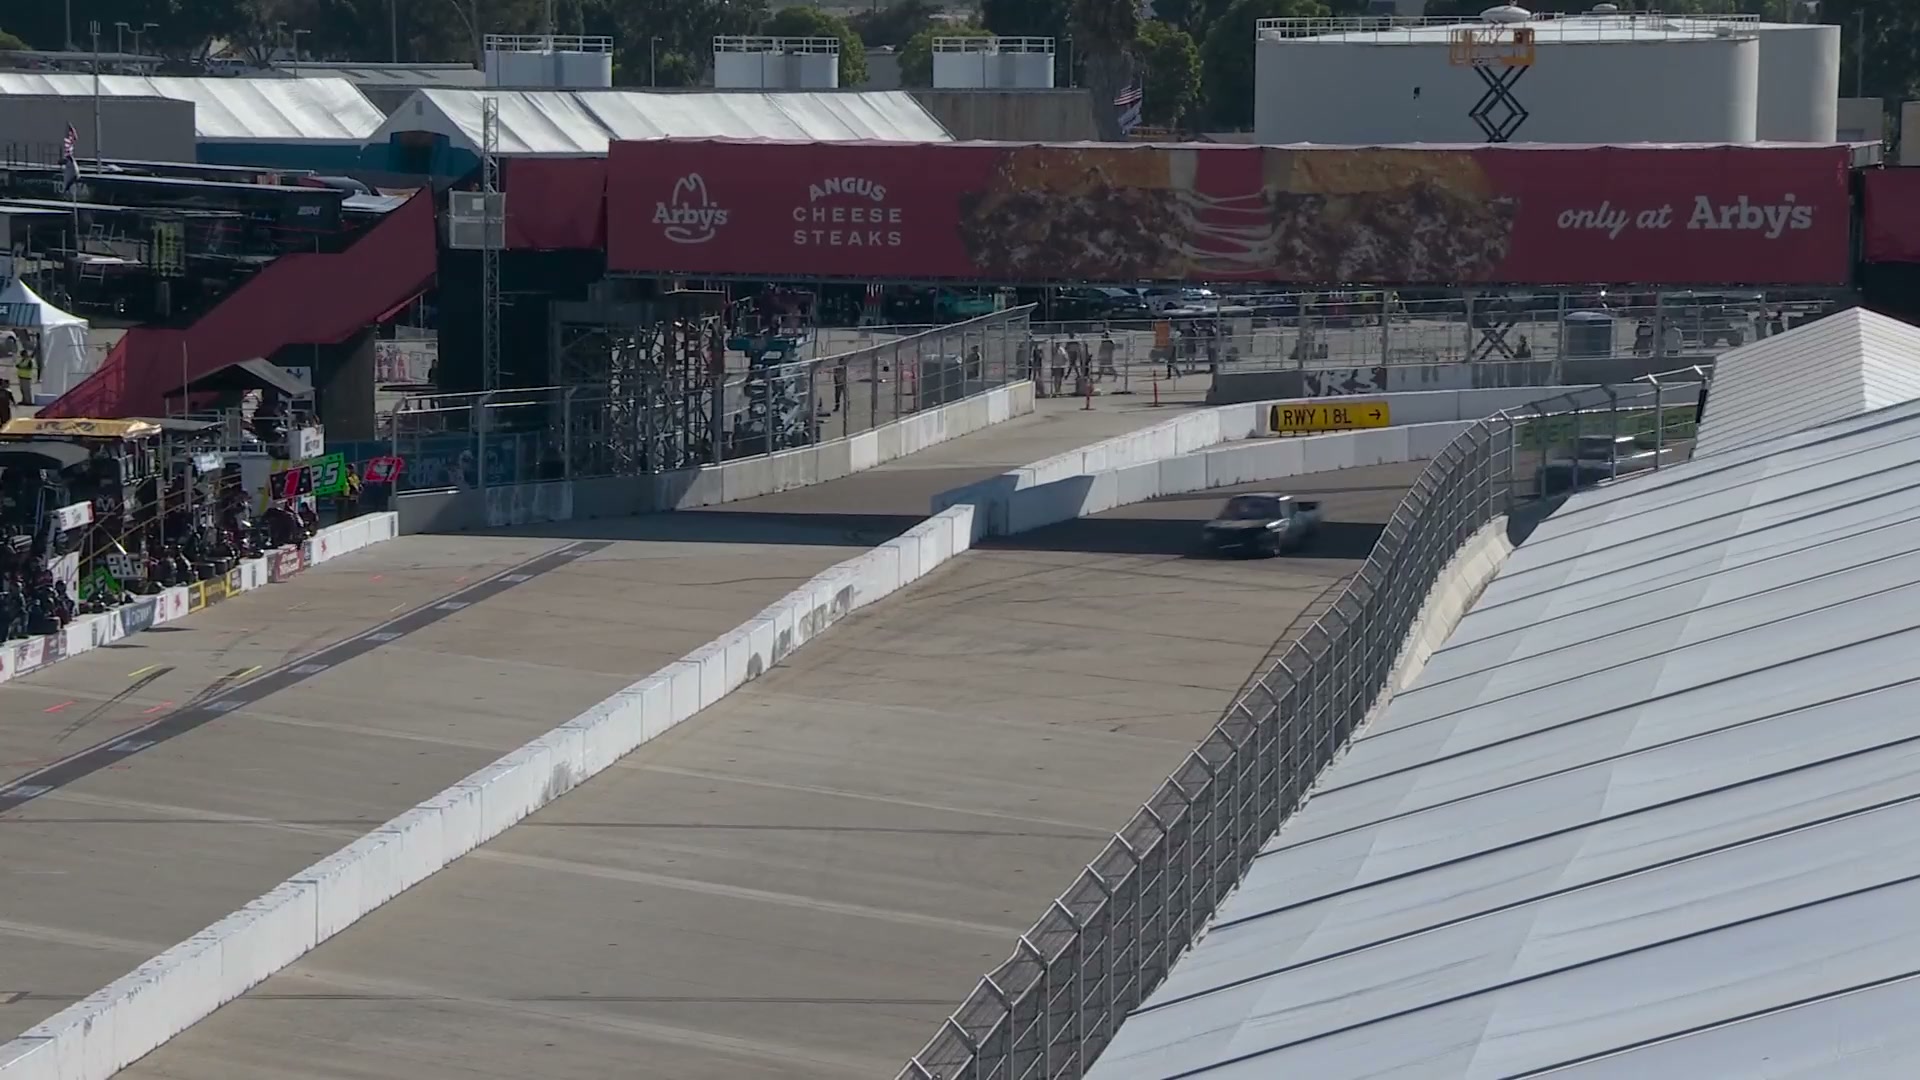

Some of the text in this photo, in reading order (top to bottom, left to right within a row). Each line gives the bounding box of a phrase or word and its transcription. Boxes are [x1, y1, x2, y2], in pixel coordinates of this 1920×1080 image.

[52, 181, 89, 195] TOTA
[808, 177, 887, 202] ANGUS
[652, 201, 728, 231] Arby's
[792, 206, 902, 223] CHEESE
[1557, 193, 1813, 240] only at Arby's
[793, 229, 902, 246] STEAKS
[1283, 408, 1316, 426] RWY
[281, 467, 302, 497] 1
[311, 461, 340, 490] 25
